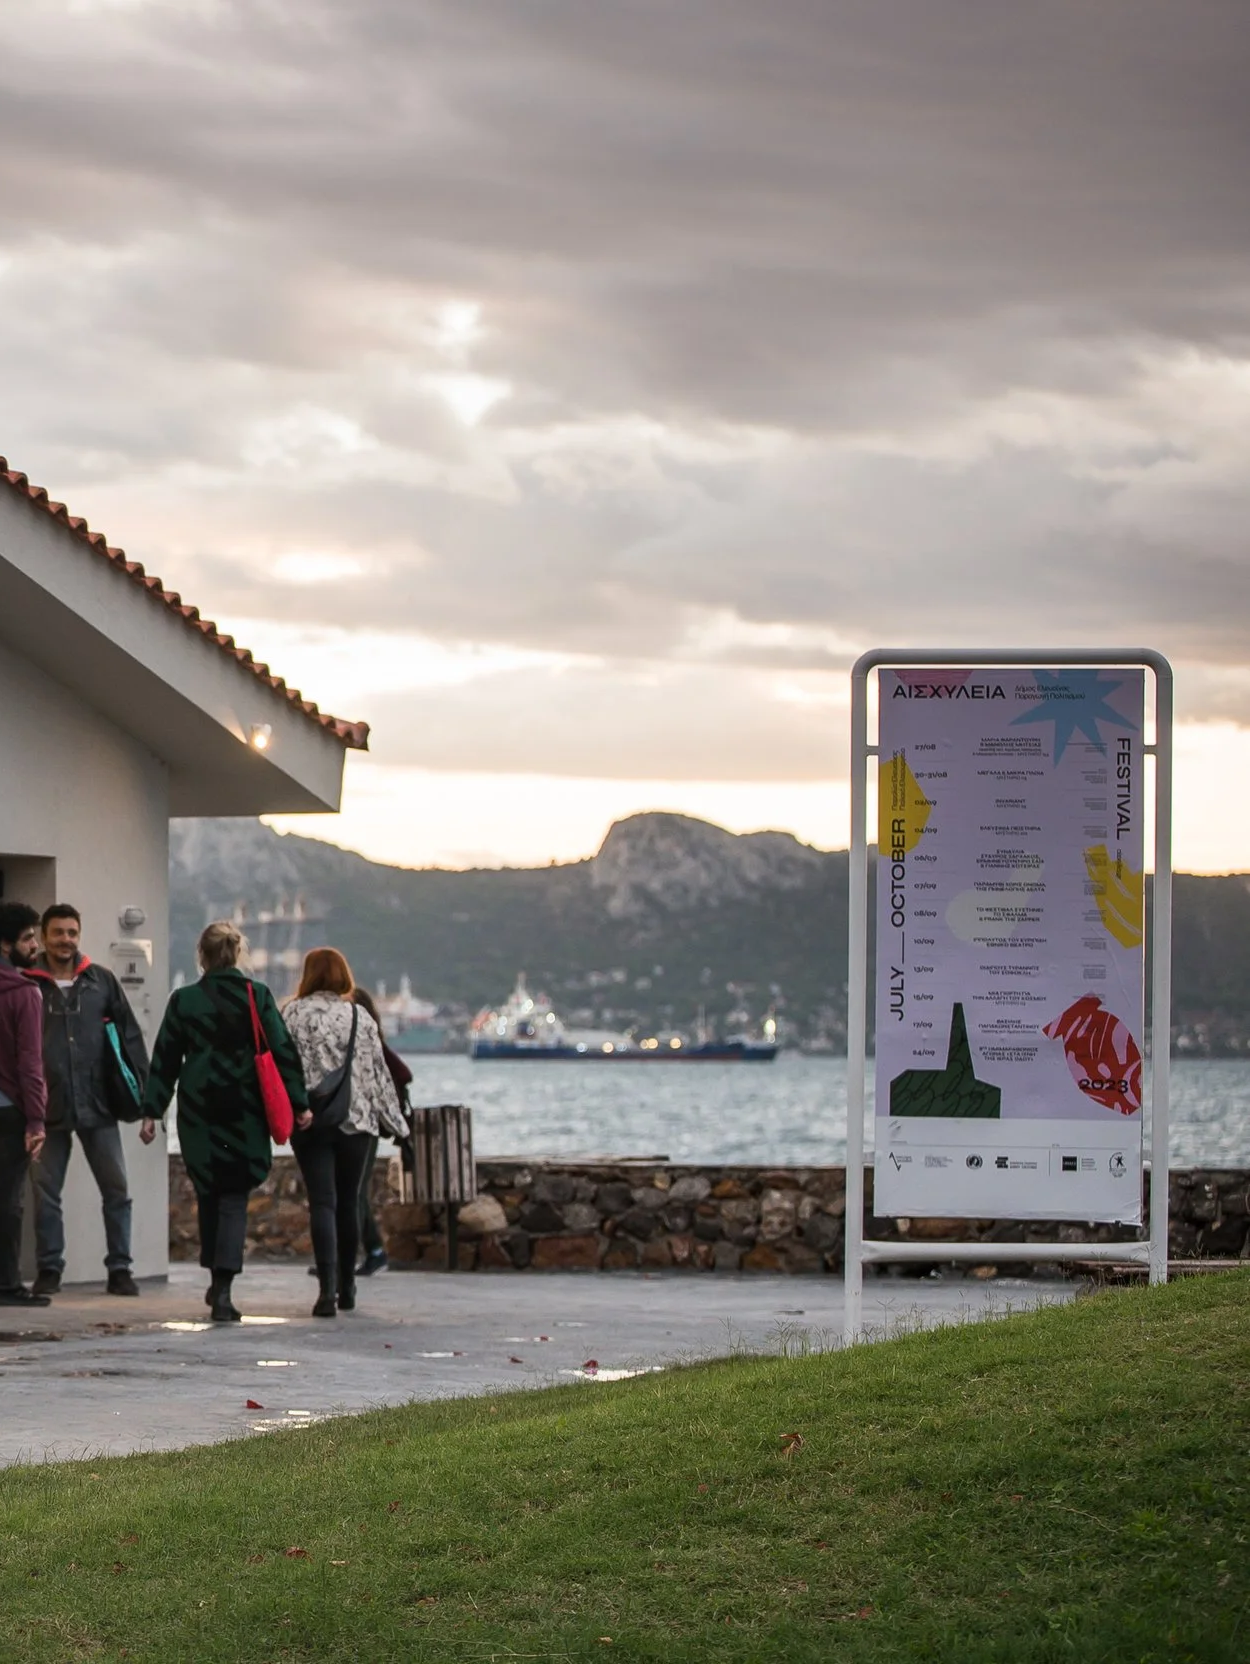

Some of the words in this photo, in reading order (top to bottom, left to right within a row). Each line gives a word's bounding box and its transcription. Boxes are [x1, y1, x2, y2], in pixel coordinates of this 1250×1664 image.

[892, 684, 1007, 700] ΑΙΣΧΥΛΕΙΑ
[1116, 737, 1131, 840] FESTIVAL
[891, 817, 906, 928] OCTOBER
[890, 965, 905, 1022] JULY
[1078, 1078, 1129, 1093] 2023
